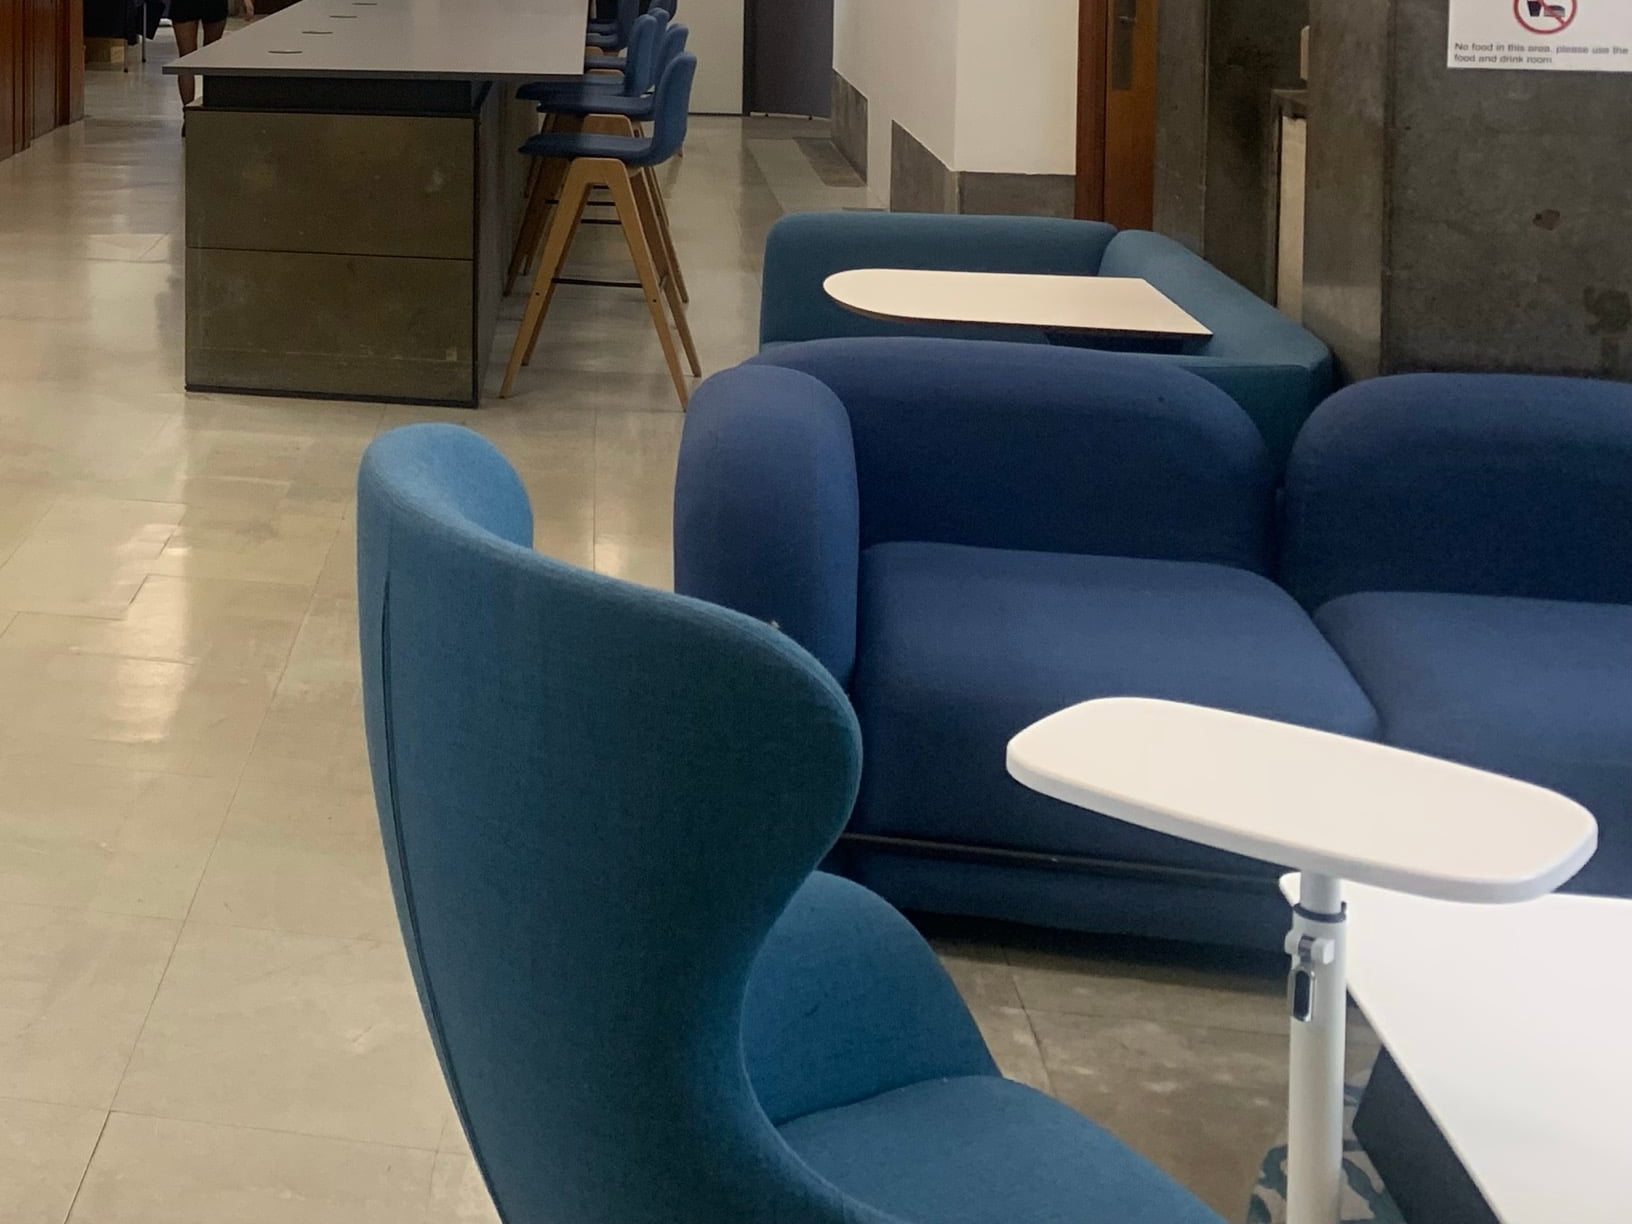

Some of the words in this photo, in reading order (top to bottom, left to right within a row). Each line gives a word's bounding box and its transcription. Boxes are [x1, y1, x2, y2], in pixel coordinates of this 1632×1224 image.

[1454, 42, 1469, 51] No
[1472, 42, 1494, 51] food
[1496, 43, 1505, 52] in
[1508, 44, 1525, 52] this
[1612, 45, 1629, 54] the
[1454, 54, 1476, 63] food
[1479, 55, 1498, 63] and
[1527, 56, 1553, 64] room
